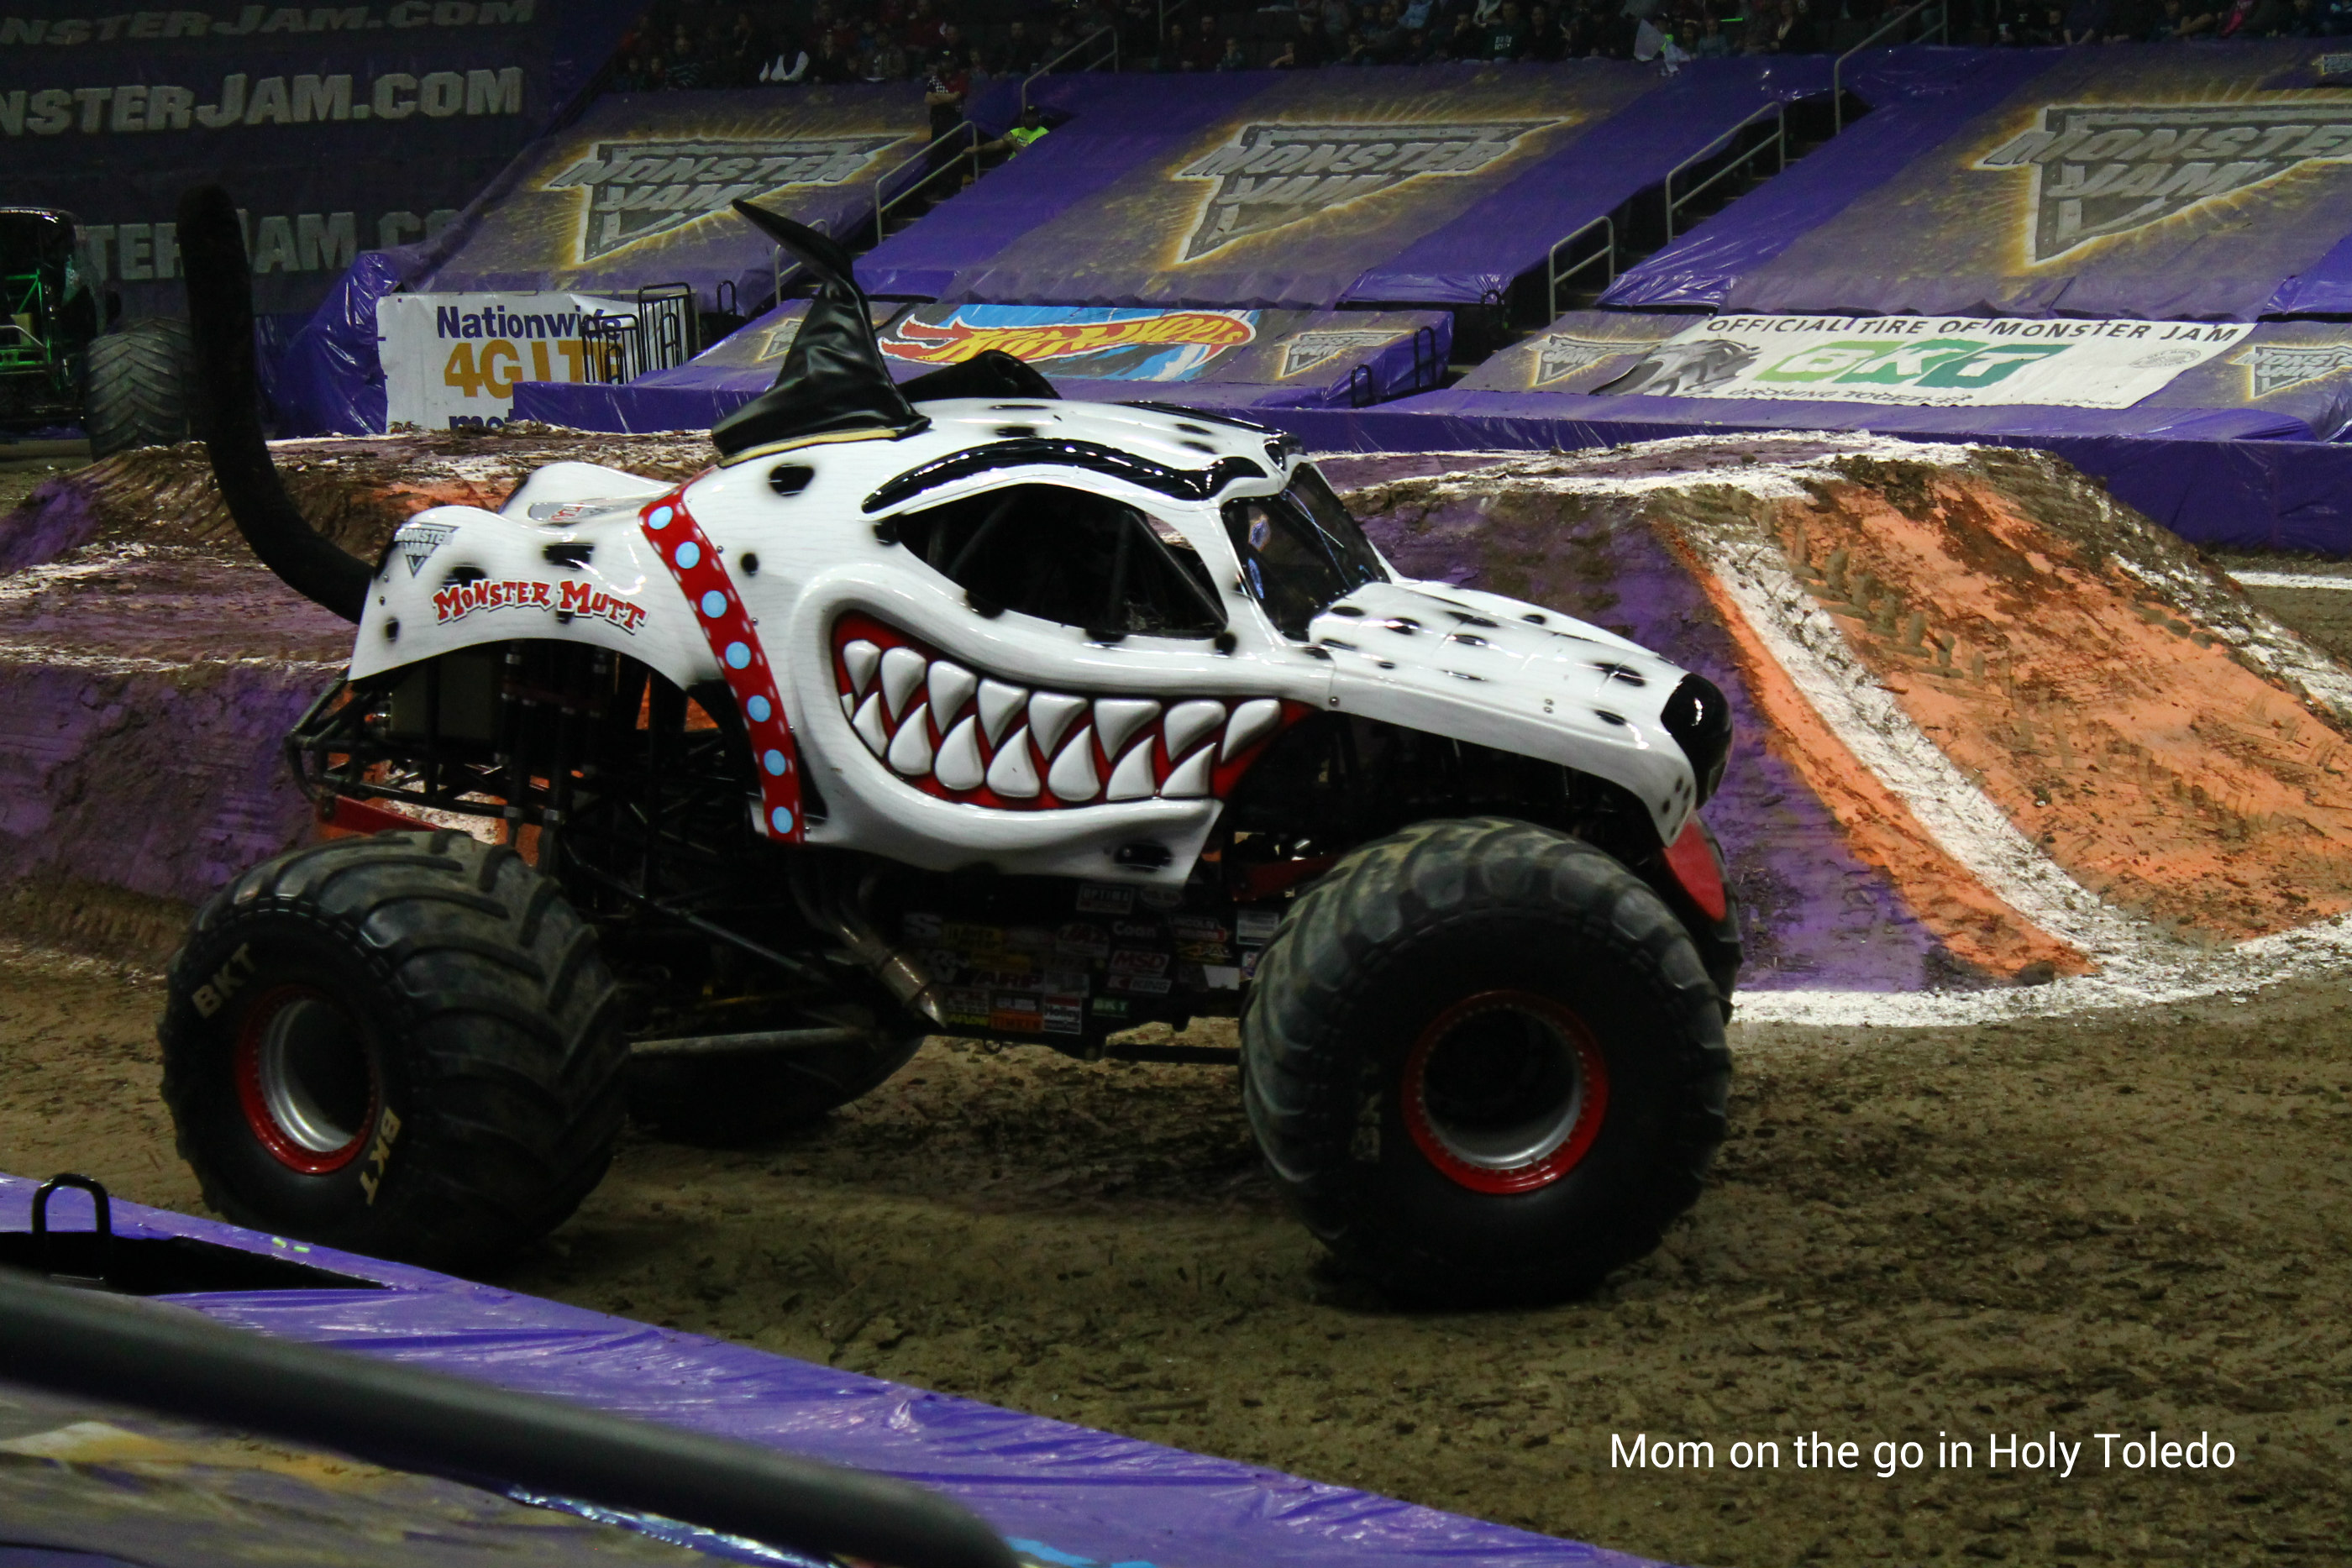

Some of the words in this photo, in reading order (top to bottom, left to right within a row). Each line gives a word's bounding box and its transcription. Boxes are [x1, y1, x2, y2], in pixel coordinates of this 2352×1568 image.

[550, 156, 872, 186] MONSTER
[1182, 141, 1511, 176] MONSTER
[1217, 173, 1394, 205] JAM
[2047, 160, 2278, 198] JAM
[595, 183, 763, 211] JAM
[437, 305, 622, 341] Nationwide
[1707, 318, 1844, 333] OFFICIAL
[1858, 320, 1929, 334] TIRE
[1938, 321, 1983, 334] OF
[1990, 321, 2152, 339] MONSTER
[2160, 325, 2240, 343] JAM
[444, 339, 523, 399] 4G
[1772, 346, 2052, 378] BKT
[433, 579, 552, 621] MONSTER
[557, 579, 648, 632] MUTT
[1114, 951, 1166, 971] MSD
[191, 941, 255, 1020] BKT
[1132, 979, 1168, 992] KING
[360, 1105, 402, 1207] BKT
